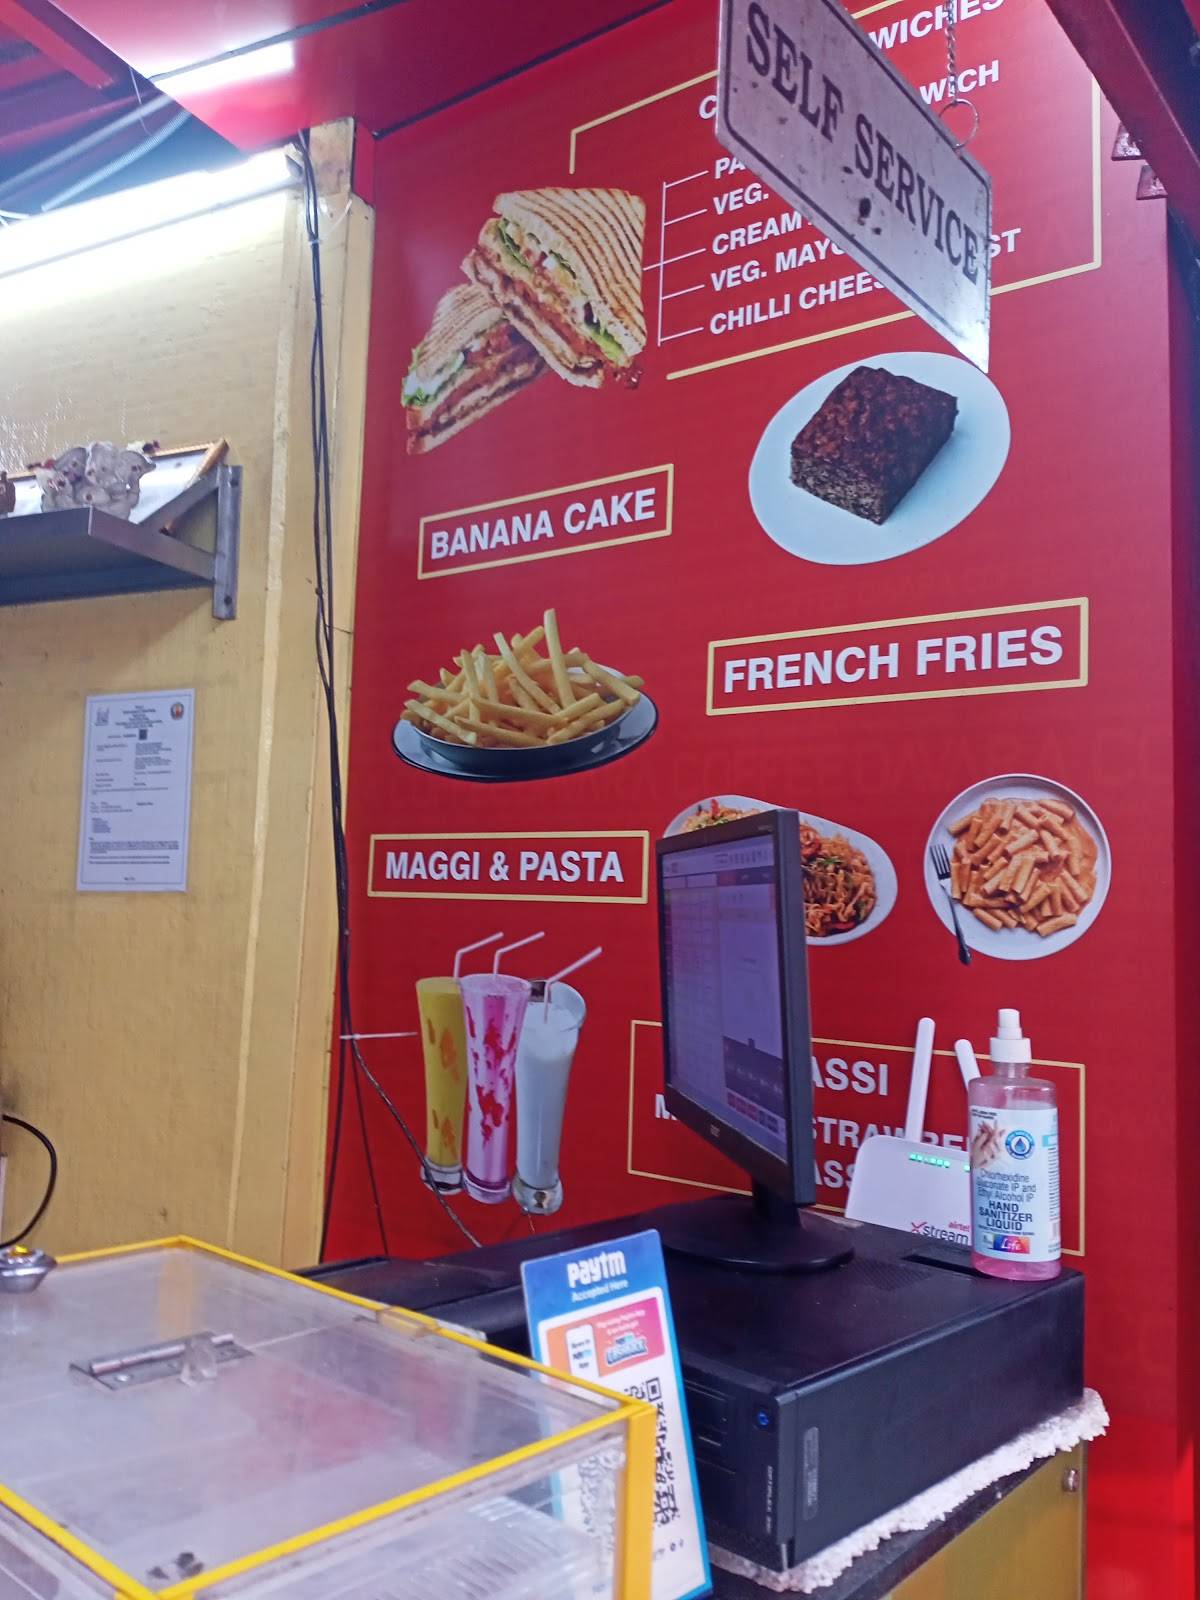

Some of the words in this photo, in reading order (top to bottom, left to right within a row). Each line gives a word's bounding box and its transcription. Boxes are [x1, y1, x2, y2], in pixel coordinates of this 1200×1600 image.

[747, 2, 844, 143] SELF
[855, 113, 978, 285] SERVICE
[713, 183, 769, 215] VEG.
[712, 210, 803, 255] CREAM
[711, 260, 767, 291] VEG.
[709, 294, 791, 335] CHILLI
[799, 271, 885, 309] CHEE
[430, 510, 554, 559] BANANA
[563, 488, 656, 534] CAKE
[723, 643, 899, 693] FRENCH
[916, 625, 1064, 676] FRIES
[385, 851, 480, 880] MAGGI
[488, 851, 510, 881] &
[519, 851, 624, 882] PASTA
[979, 1207, 1033, 1222] SANITIZER
[988, 1200, 1019, 1212] HAND
[986, 1218, 1023, 1230] LIQUID
